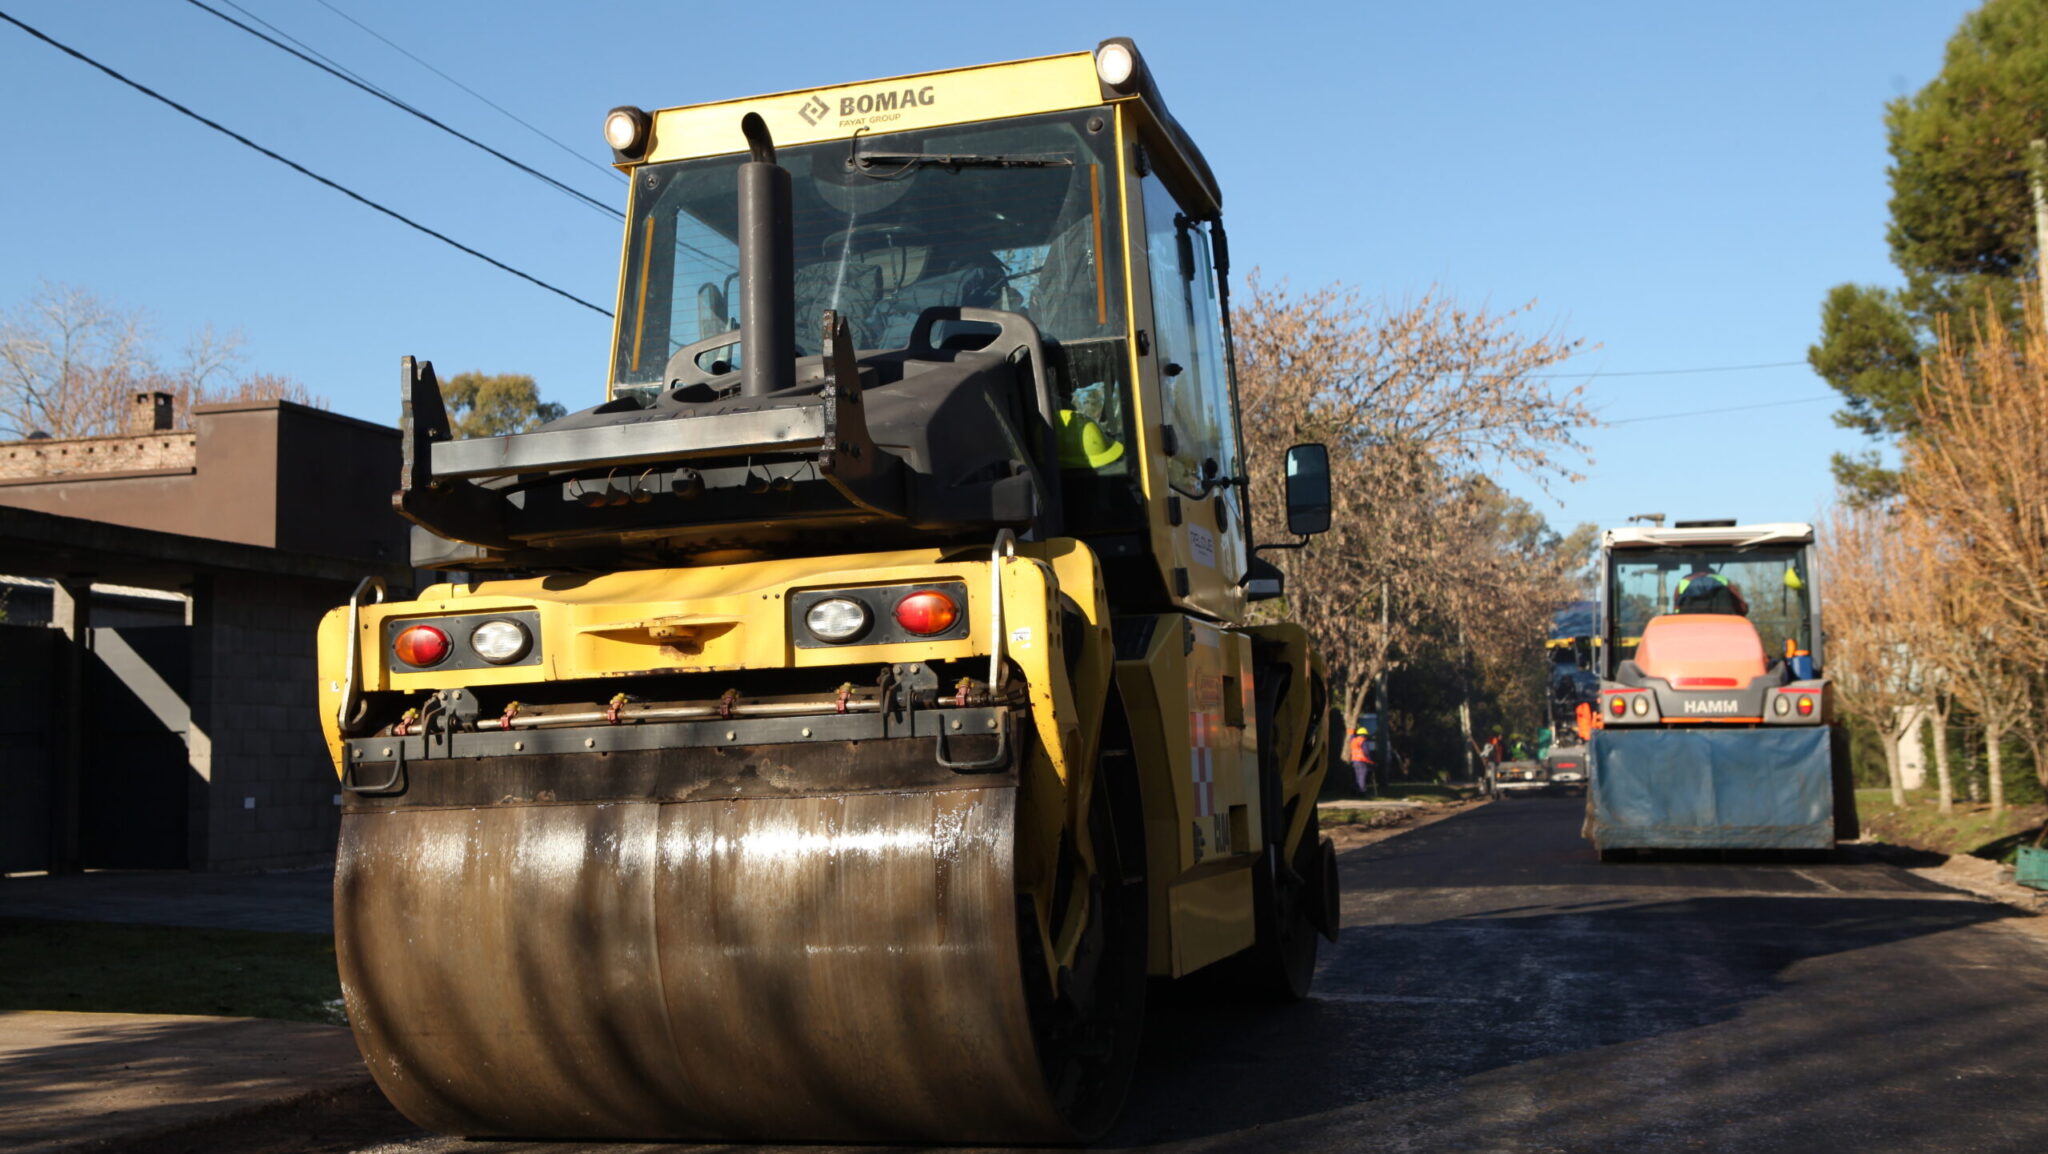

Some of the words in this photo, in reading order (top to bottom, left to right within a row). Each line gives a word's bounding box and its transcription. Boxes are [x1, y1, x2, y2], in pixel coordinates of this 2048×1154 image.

[839, 86, 935, 117] BOMAG
[839, 117, 866, 127] FAYAT
[869, 113, 901, 124] GROUP
[1684, 700, 1738, 713] HAMM
